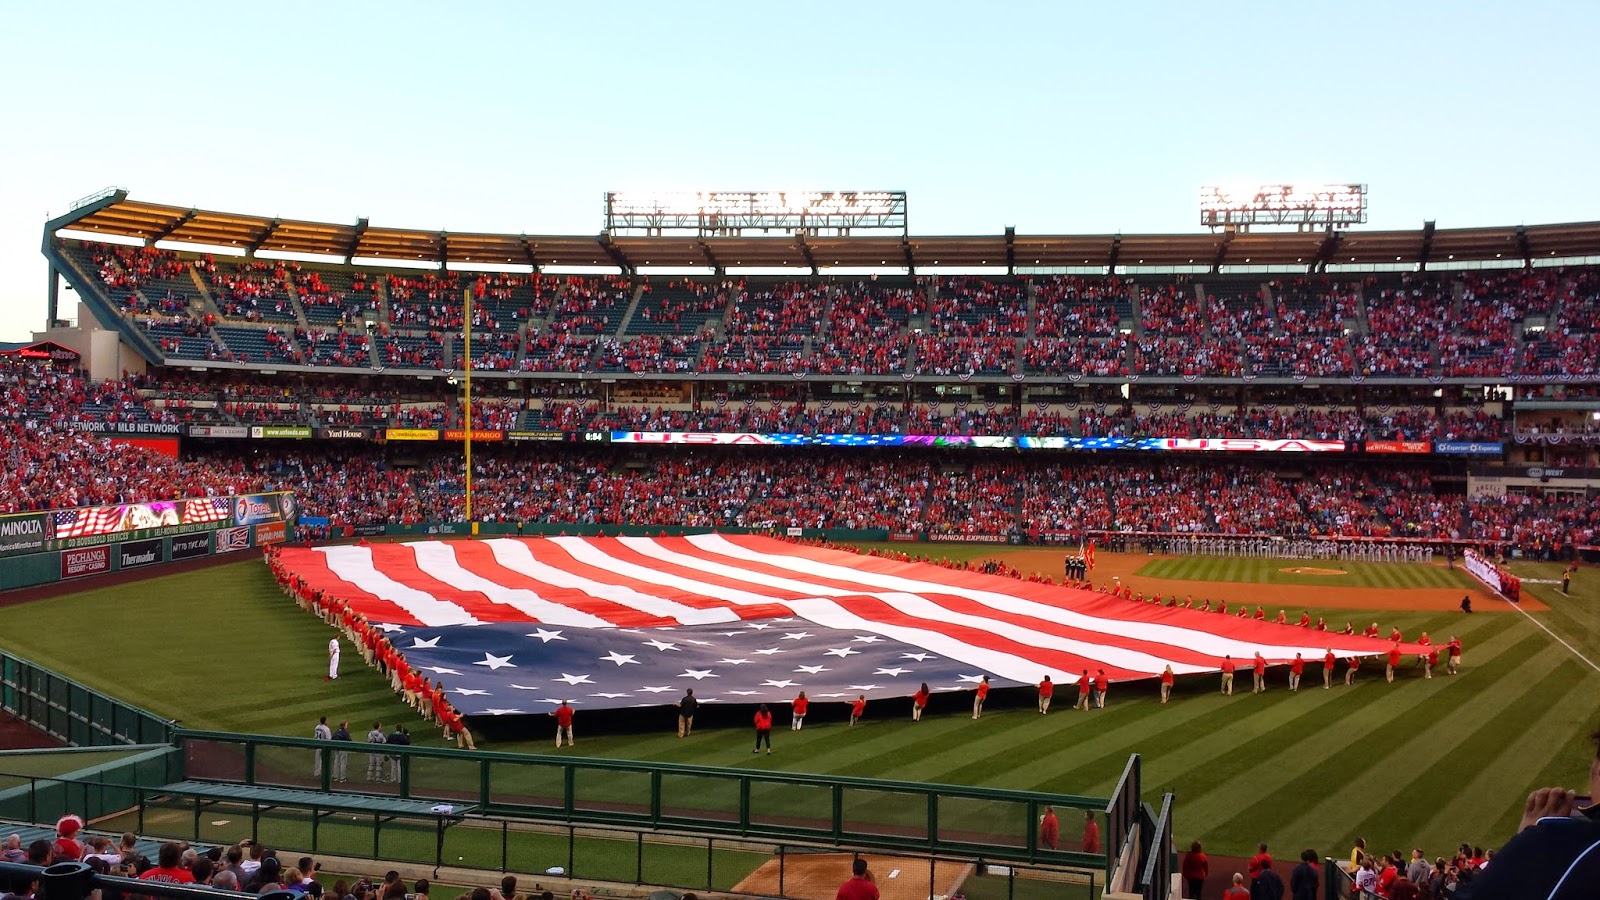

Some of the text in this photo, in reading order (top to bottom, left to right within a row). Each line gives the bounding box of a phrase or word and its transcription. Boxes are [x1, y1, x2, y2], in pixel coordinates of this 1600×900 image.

[118, 423, 179, 434] MLB NETWORK
[328, 430, 362, 438] Yard House
[585, 432, 602, 441] 6:54
[633, 433, 763, 445] USA
[1167, 439, 1312, 451] USA
[249, 502, 270, 512] TOTAL
[1, 519, 42, 537] MINOLTA
[966, 534, 998, 542] EXPRESS
[67, 550, 106, 565] PECHANGA
[122, 550, 156, 566] Thermador
[67, 561, 106, 574] RESORT CASINO
